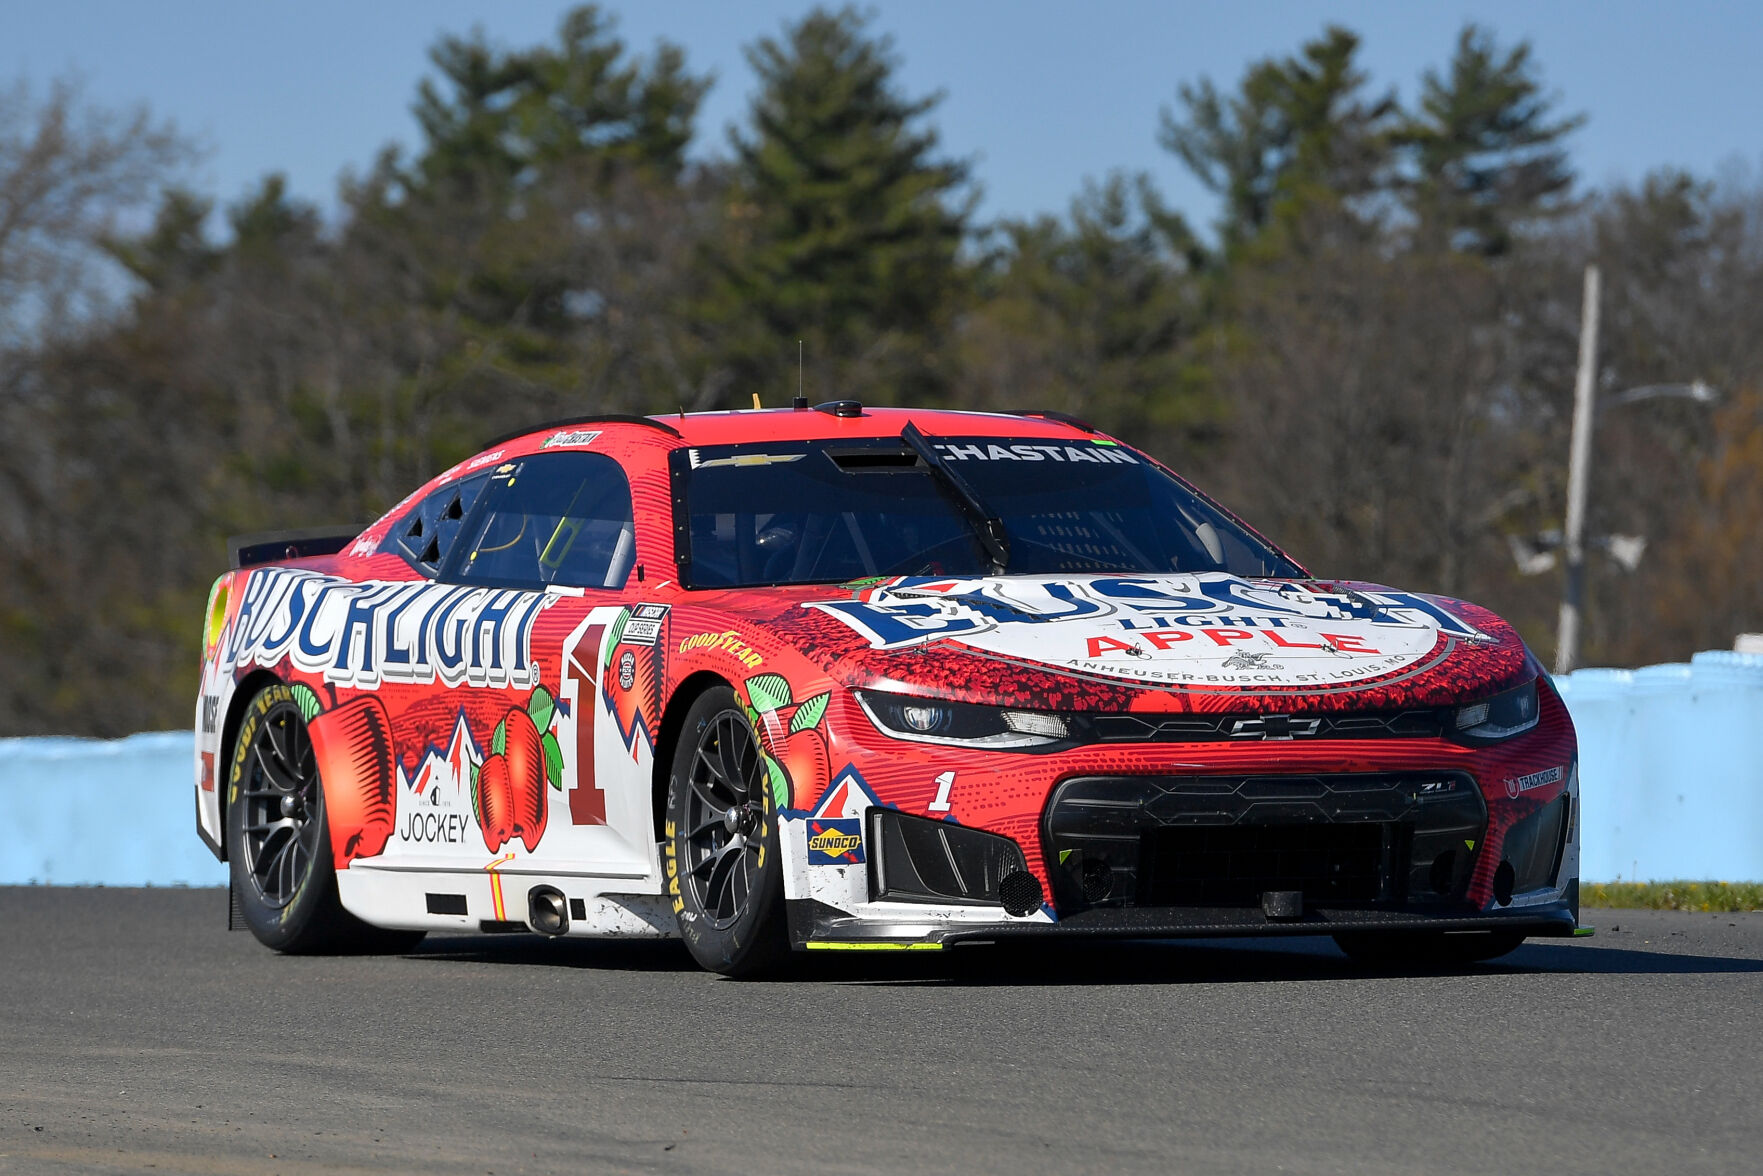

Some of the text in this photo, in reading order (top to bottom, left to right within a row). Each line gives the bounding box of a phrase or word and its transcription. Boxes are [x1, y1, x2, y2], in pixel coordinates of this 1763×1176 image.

[226, 567, 558, 673] BUSCH LIGHT
[1119, 614, 1288, 630] LIGHT
[680, 630, 763, 669] GOODYEAR
[1086, 628, 1381, 658] APPLE
[1067, 655, 1406, 683] ANHEUSER-BUSCH, ST. LOUIS, MO
[564, 616, 614, 826] 1
[928, 771, 955, 811] 1
[1519, 768, 1560, 790] TRACKHOUSE
[401, 812, 468, 843] JOCKEY
[811, 836, 858, 849] SUNOCO
[665, 820, 684, 914] EAGLE
